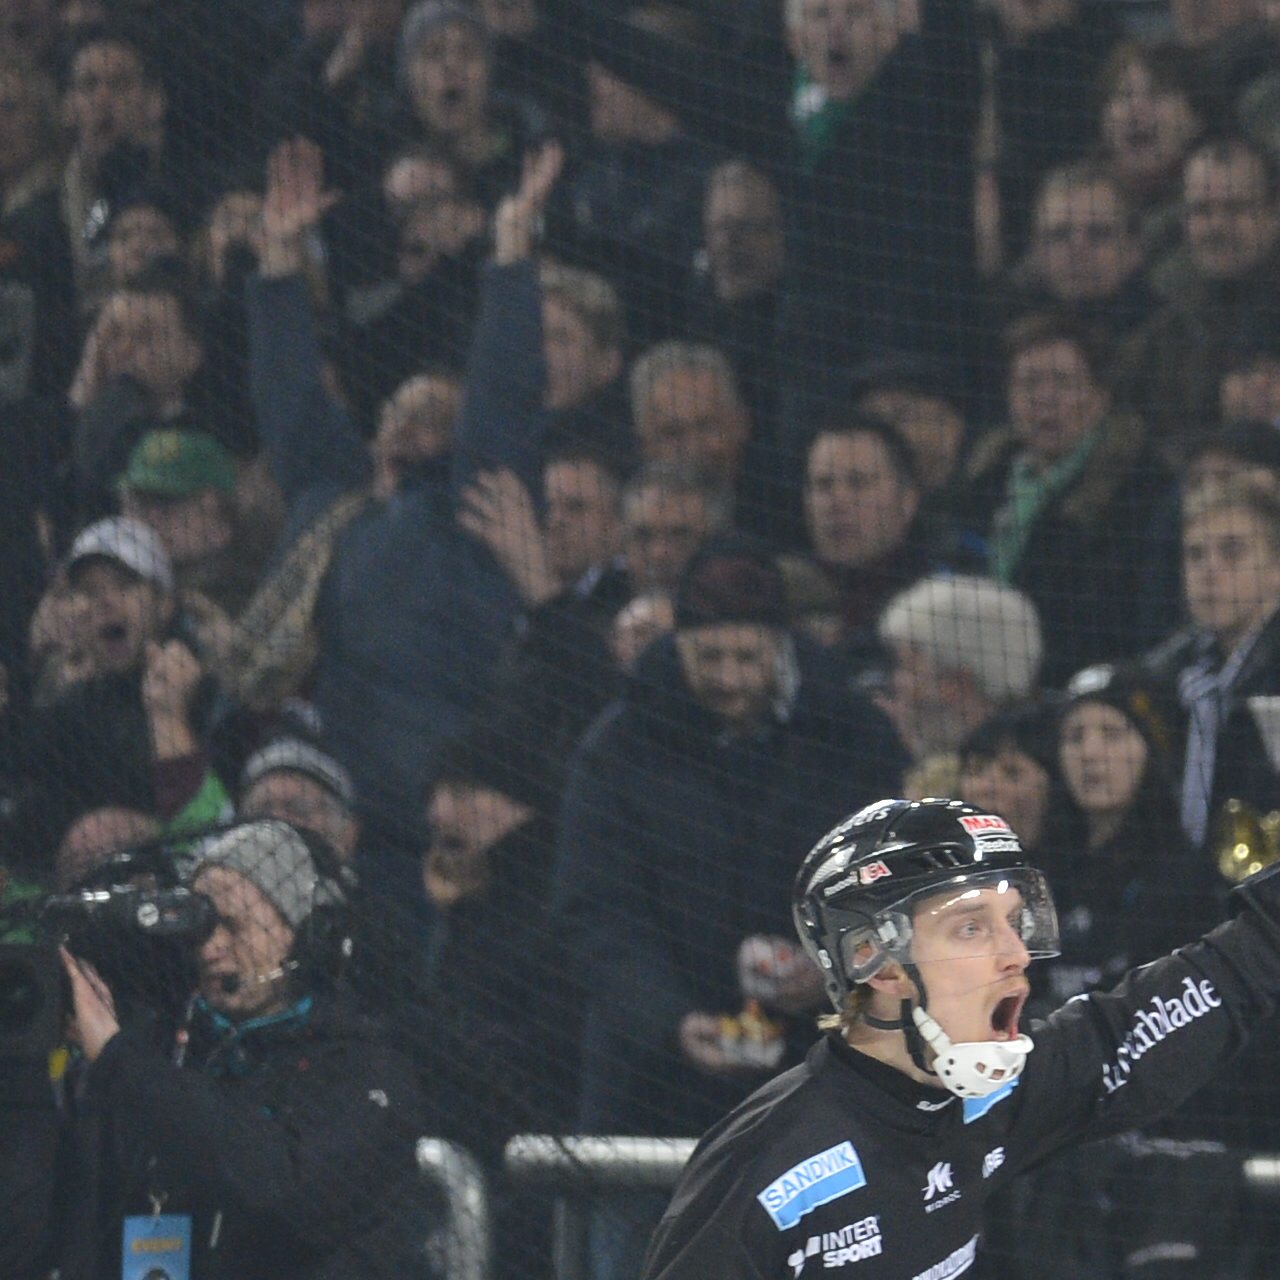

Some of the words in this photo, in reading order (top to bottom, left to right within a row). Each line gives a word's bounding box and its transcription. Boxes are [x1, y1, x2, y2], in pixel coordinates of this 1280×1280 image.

[764, 1146, 855, 1210] SANDVIK
[822, 1215, 881, 1251] INTER
[823, 1234, 883, 1268] SPORT
